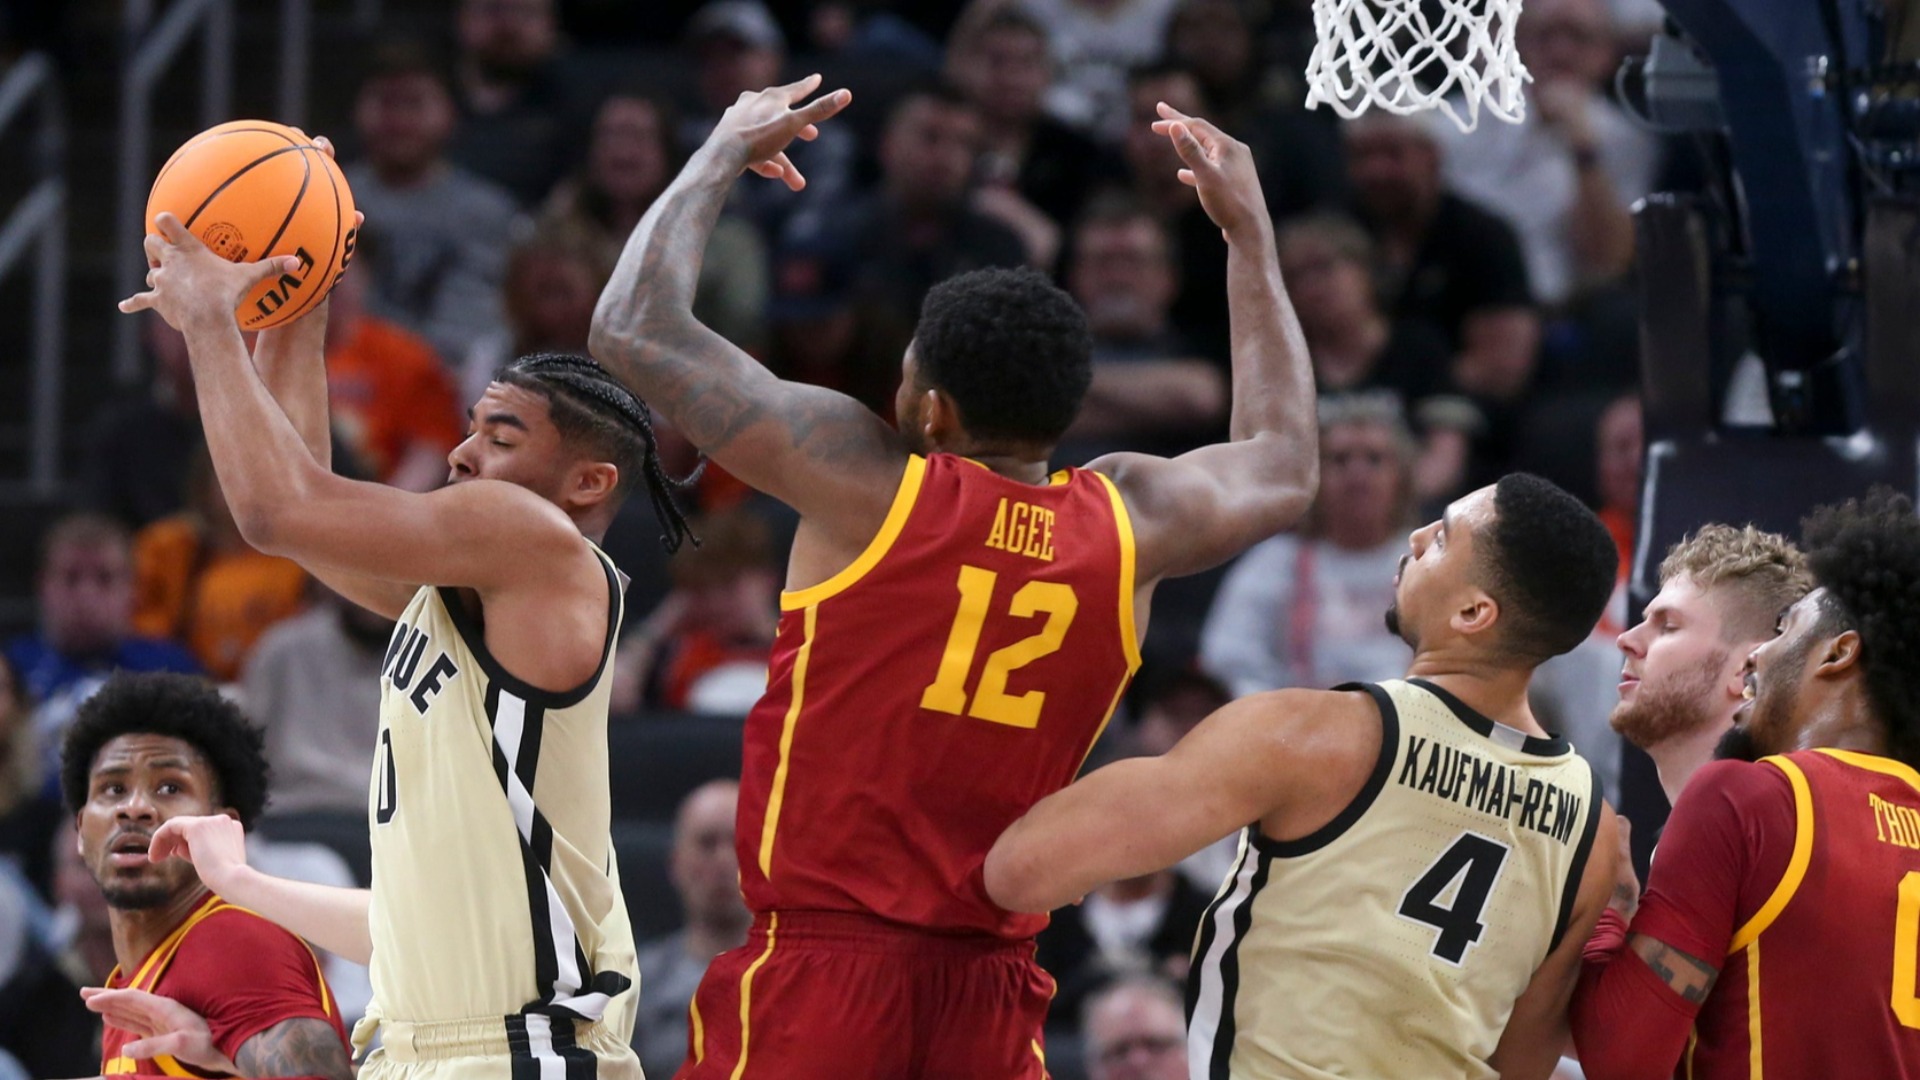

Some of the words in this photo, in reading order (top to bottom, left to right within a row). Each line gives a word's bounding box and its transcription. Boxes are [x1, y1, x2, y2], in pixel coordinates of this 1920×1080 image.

[985, 498, 1055, 561] AGEE
[919, 564, 1079, 729] 12
[1398, 832, 1509, 964] 4
